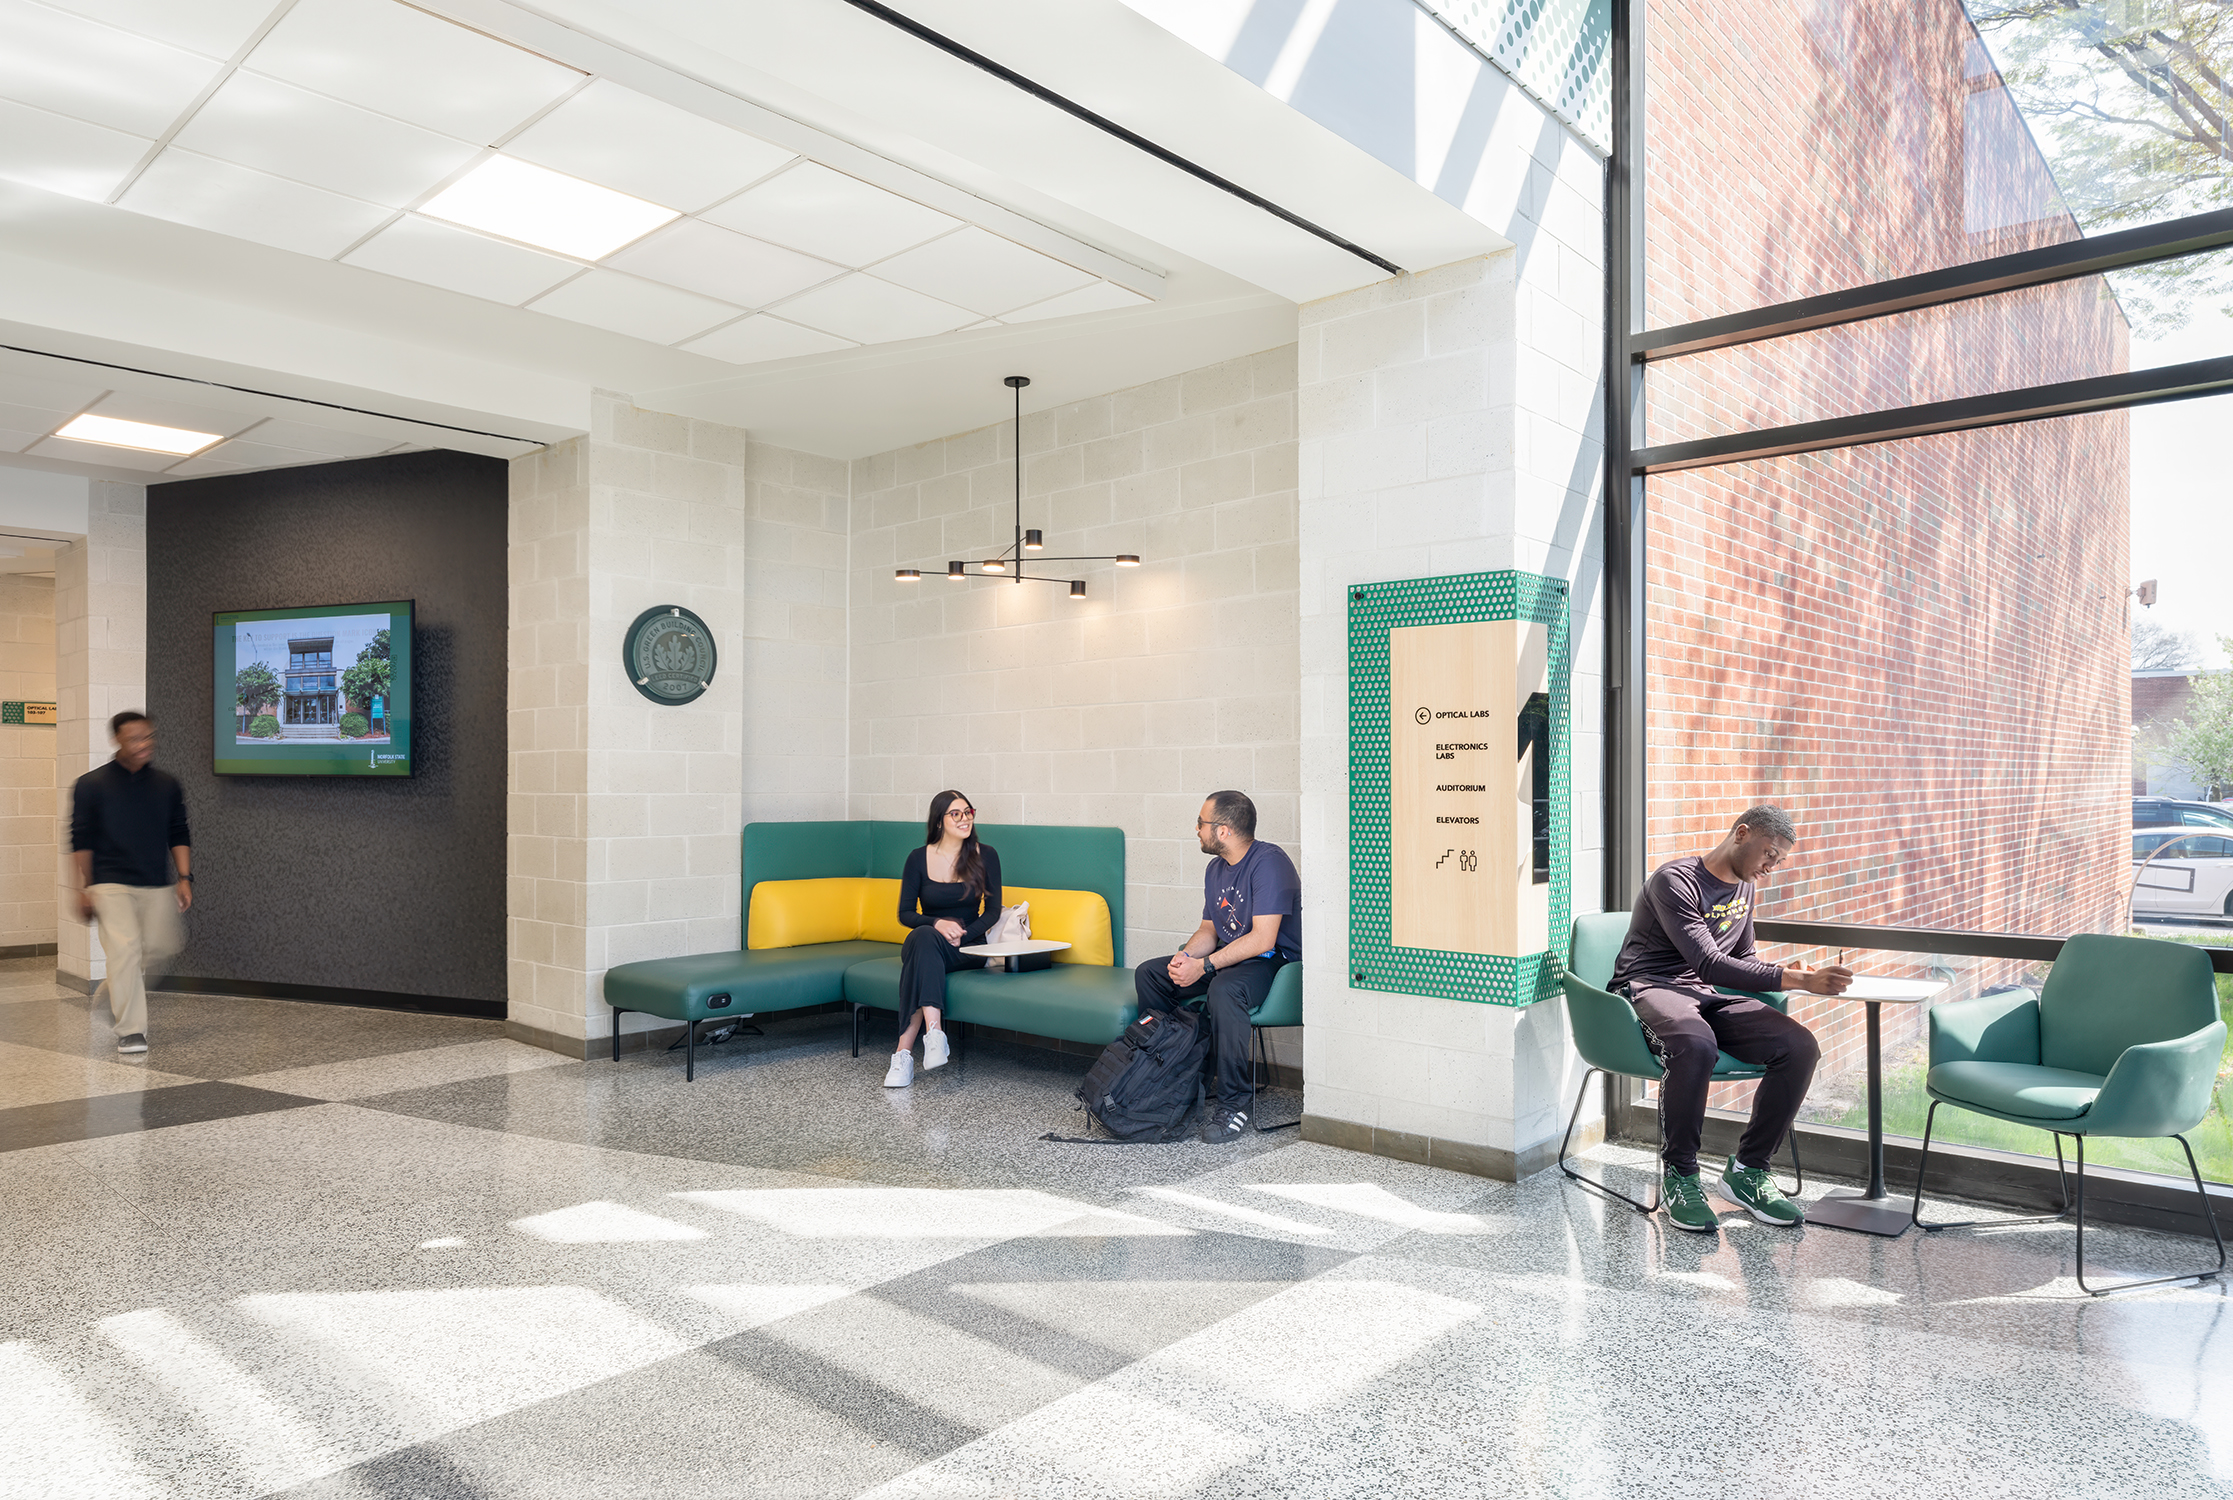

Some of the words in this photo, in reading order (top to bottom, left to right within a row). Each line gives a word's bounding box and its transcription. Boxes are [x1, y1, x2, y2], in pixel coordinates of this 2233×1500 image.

[643, 627, 660, 652] GREEN
[661, 621, 696, 635] BUILDING
[695, 637, 706, 672] COUNCIL
[668, 673, 698, 682] CERTIFIED
[663, 683, 687, 691] 2007
[1435, 711, 1468, 719] OPTICAL
[1470, 710, 1490, 718] LABS
[1435, 743, 1489, 751] ELECTRONICS
[1435, 752, 1455, 760] LABS
[1435, 784, 1486, 792] AUDITORIUM
[1436, 816, 1480, 825] ELEVATORS
